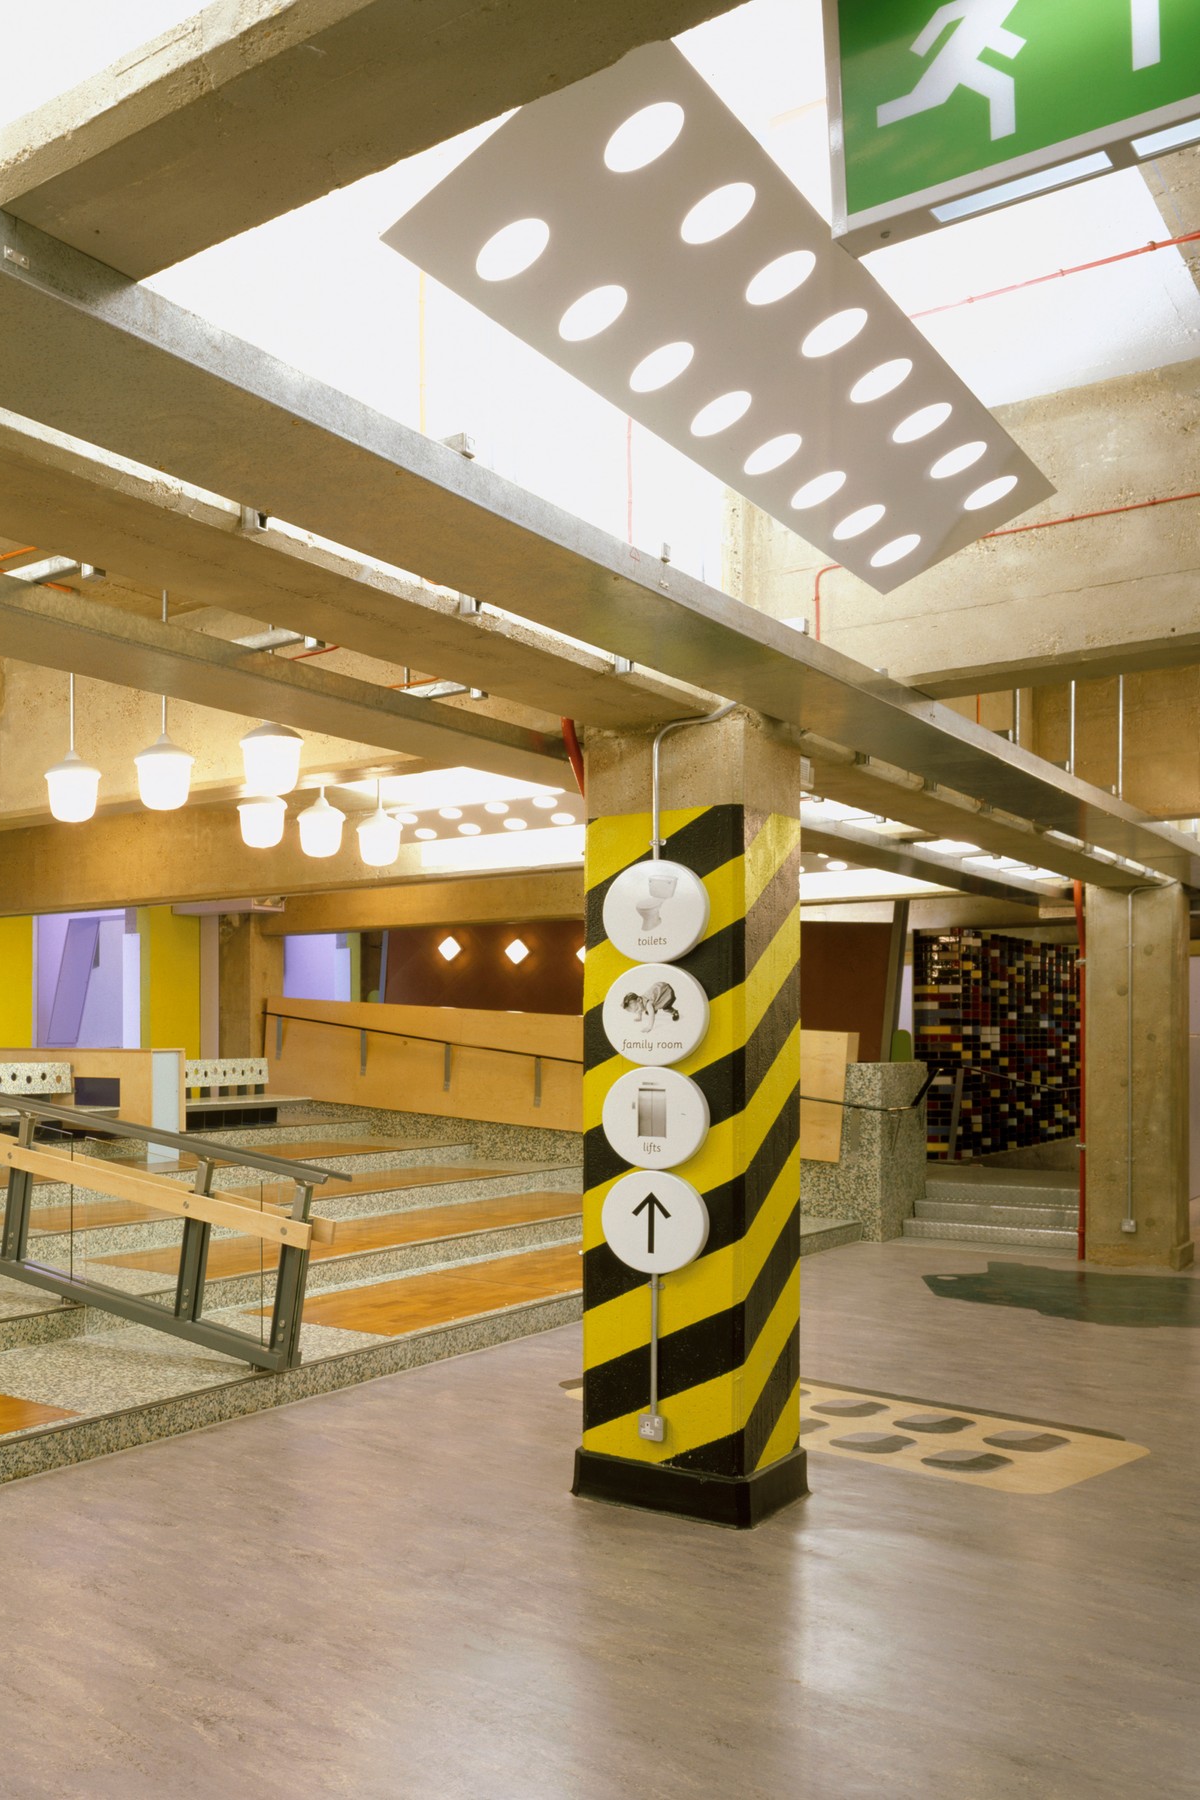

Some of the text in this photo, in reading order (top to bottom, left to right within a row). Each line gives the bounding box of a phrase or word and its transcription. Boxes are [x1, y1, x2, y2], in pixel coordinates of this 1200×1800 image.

[637, 935, 668, 946] toilets
[621, 1038, 683, 1052] family room
[642, 1141, 662, 1155] lifts
